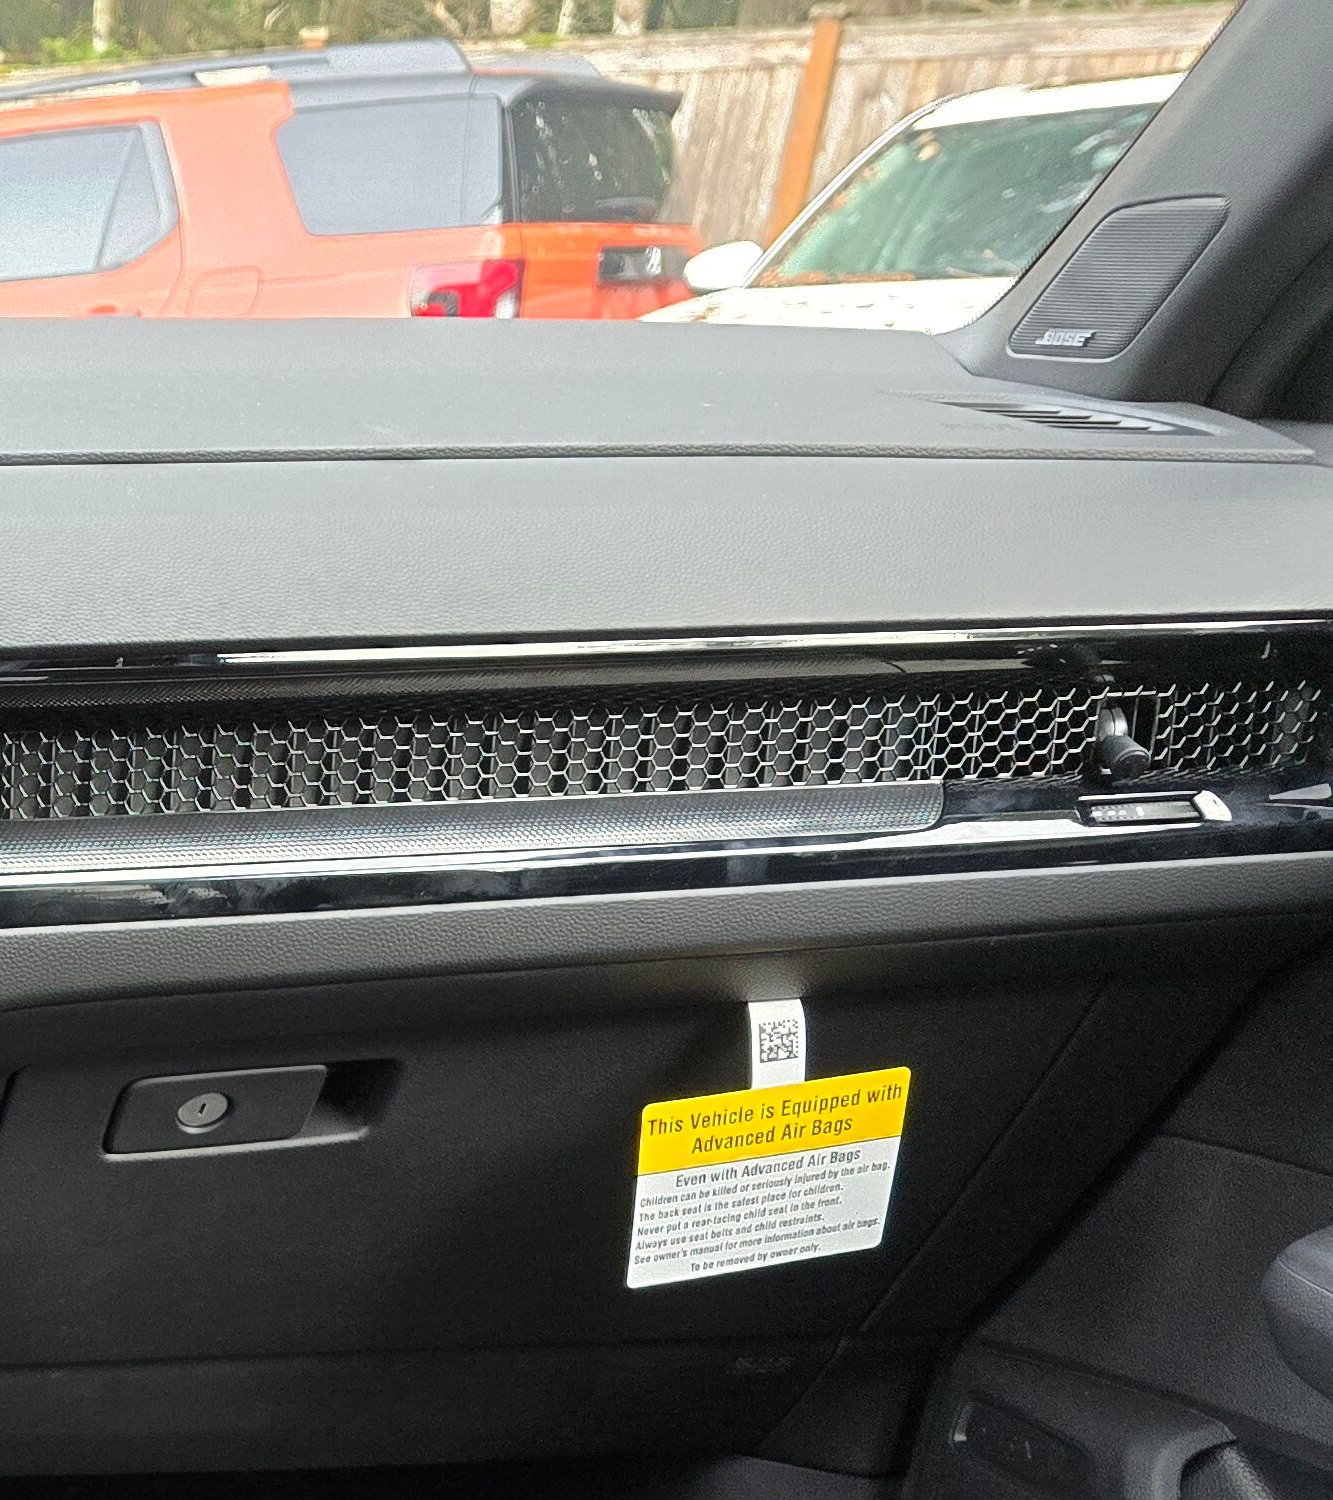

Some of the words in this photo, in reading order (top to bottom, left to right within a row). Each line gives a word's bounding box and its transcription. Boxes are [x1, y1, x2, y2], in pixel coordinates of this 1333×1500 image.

[1039, 329, 1089, 347] BOSE
[647, 1116, 684, 1137] This
[690, 1106, 754, 1130] Vehicle
[760, 1103, 775, 1120] is
[780, 1088, 862, 1118] Equipped
[867, 1083, 903, 1104] with
[691, 1125, 776, 1154] Advanced
[780, 1123, 807, 1141] Air
[811, 1117, 854, 1137] Bags
[640, 1194, 678, 1208] Children
[680, 1192, 697, 1202] can
[699, 1188, 710, 1199] be
[712, 1183, 738, 1197] killed
[739, 1183, 749, 1193] or
[751, 1176, 793, 1192] seriously
[794, 1169, 826, 1185] injured
[827, 1168, 839, 1180] by
[840, 1165, 855, 1177] the
[856, 1163, 870, 1175] air
[675, 1172, 707, 1188] Even
[710, 1167, 738, 1183] with
[741, 1155, 805, 1178] Advanced
[807, 1153, 827, 1168] Air
[829, 1149, 862, 1164] Bags
[637, 1225, 664, 1237] Never
[666, 1221, 681, 1234] put
[683, 1221, 689, 1229] a
[691, 1212, 742, 1229] rear-facing
[743, 1206, 766, 1220] child
[768, 1204, 788, 1216] seat
[789, 1203, 799, 1213] in
[800, 1200, 816, 1211] the
[639, 1212, 655, 1222] The
[658, 1207, 680, 1220] back
[681, 1203, 702, 1216] seat
[703, 1202, 712, 1213] is
[714, 1200, 729, 1211] the
[731, 1195, 759, 1209] safest
[761, 1191, 787, 1206] place
[788, 1188, 802, 1200] for
[634, 1255, 652, 1265] See
[653, 1247, 688, 1262] owner's
[689, 1242, 723, 1257] manual
[724, 1239, 738, 1251] for
[738, 1236, 763, 1248] more
[763, 1227, 815, 1245] information
[815, 1222, 841, 1237] about
[841, 1220, 856, 1232] air
[635, 1238, 668, 1252] Always
[670, 1235, 687, 1246] use
[688, 1230, 709, 1243] seat
[710, 1227, 734, 1240] belts
[735, 1223, 753, 1235] and
[754, 1220, 779, 1233] child
[690, 1262, 701, 1273] To
[702, 1259, 715, 1271] be
[716, 1254, 756, 1268] removed
[757, 1251, 769, 1262] by
[769, 1246, 799, 1258] owner
[799, 1243, 821, 1255] only.
